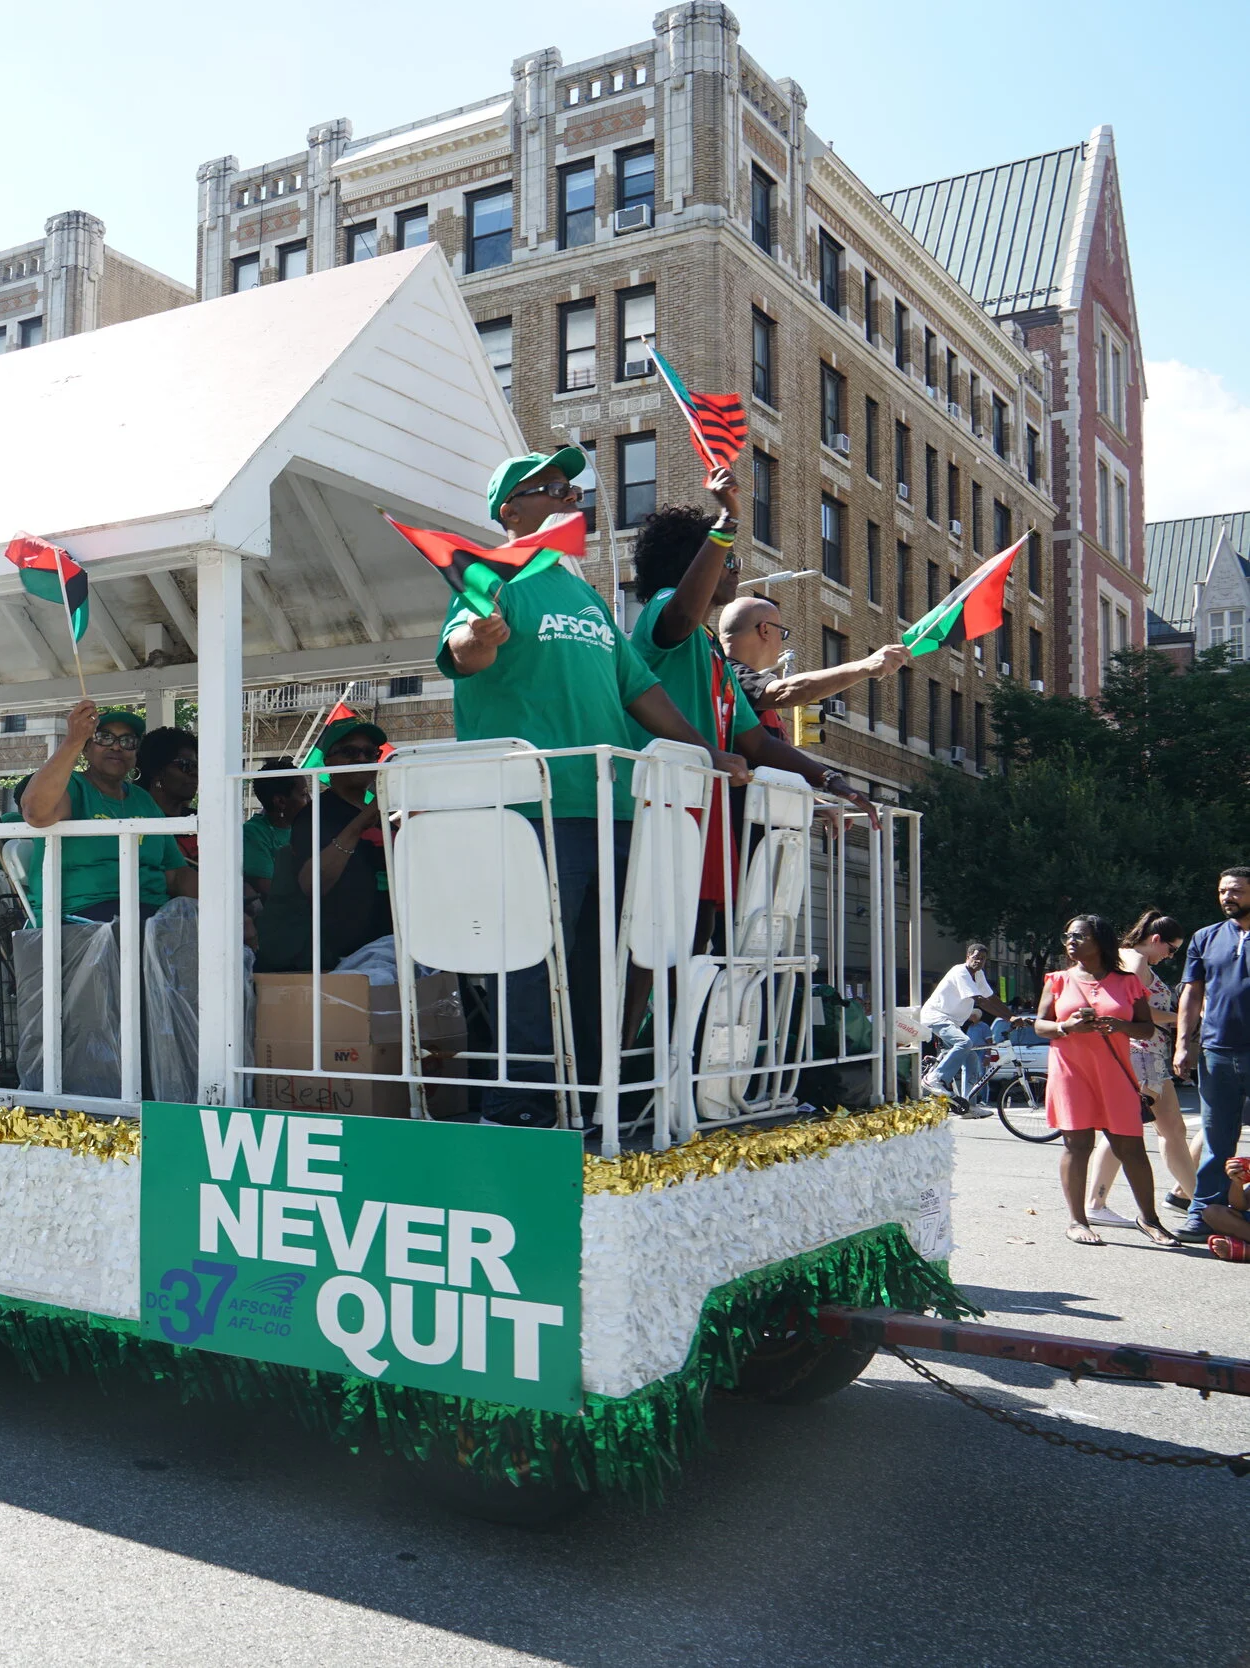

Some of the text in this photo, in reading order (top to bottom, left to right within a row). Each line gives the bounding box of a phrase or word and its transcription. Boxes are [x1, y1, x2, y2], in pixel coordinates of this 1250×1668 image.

[334, 1048, 359, 1062] NYC
[199, 1109, 343, 1192] WE
[199, 1183, 521, 1294] NEVER
[145, 1259, 237, 1344] DC 37
[227, 1297, 293, 1320] AFSCME
[227, 1315, 292, 1337] AFL-CIO
[316, 1275, 564, 1382] QUIT
